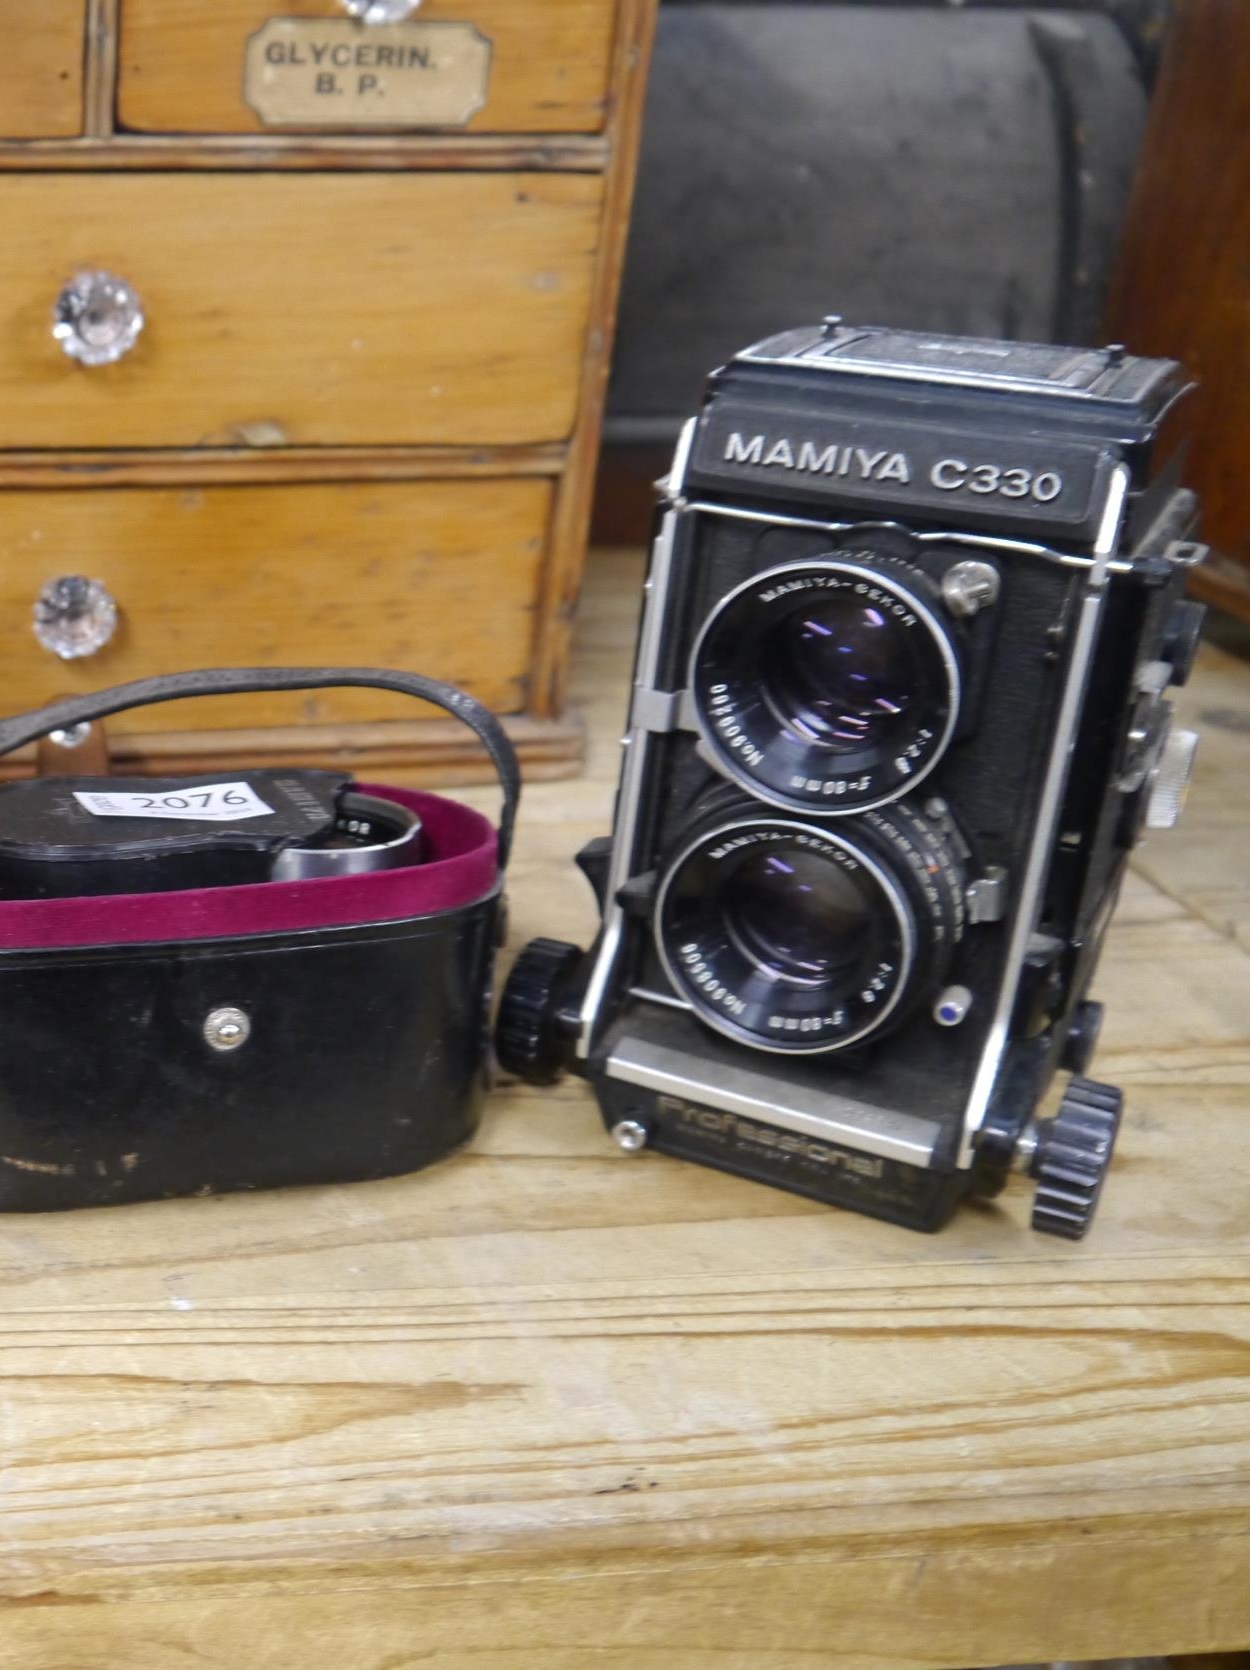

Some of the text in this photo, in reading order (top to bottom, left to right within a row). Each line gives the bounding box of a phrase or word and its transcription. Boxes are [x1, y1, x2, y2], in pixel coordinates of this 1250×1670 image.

[264, 41, 438, 70] GLYCERIN.
[724, 432, 1063, 502] MAMIYA C330
[131, 790, 247, 809] 2076
